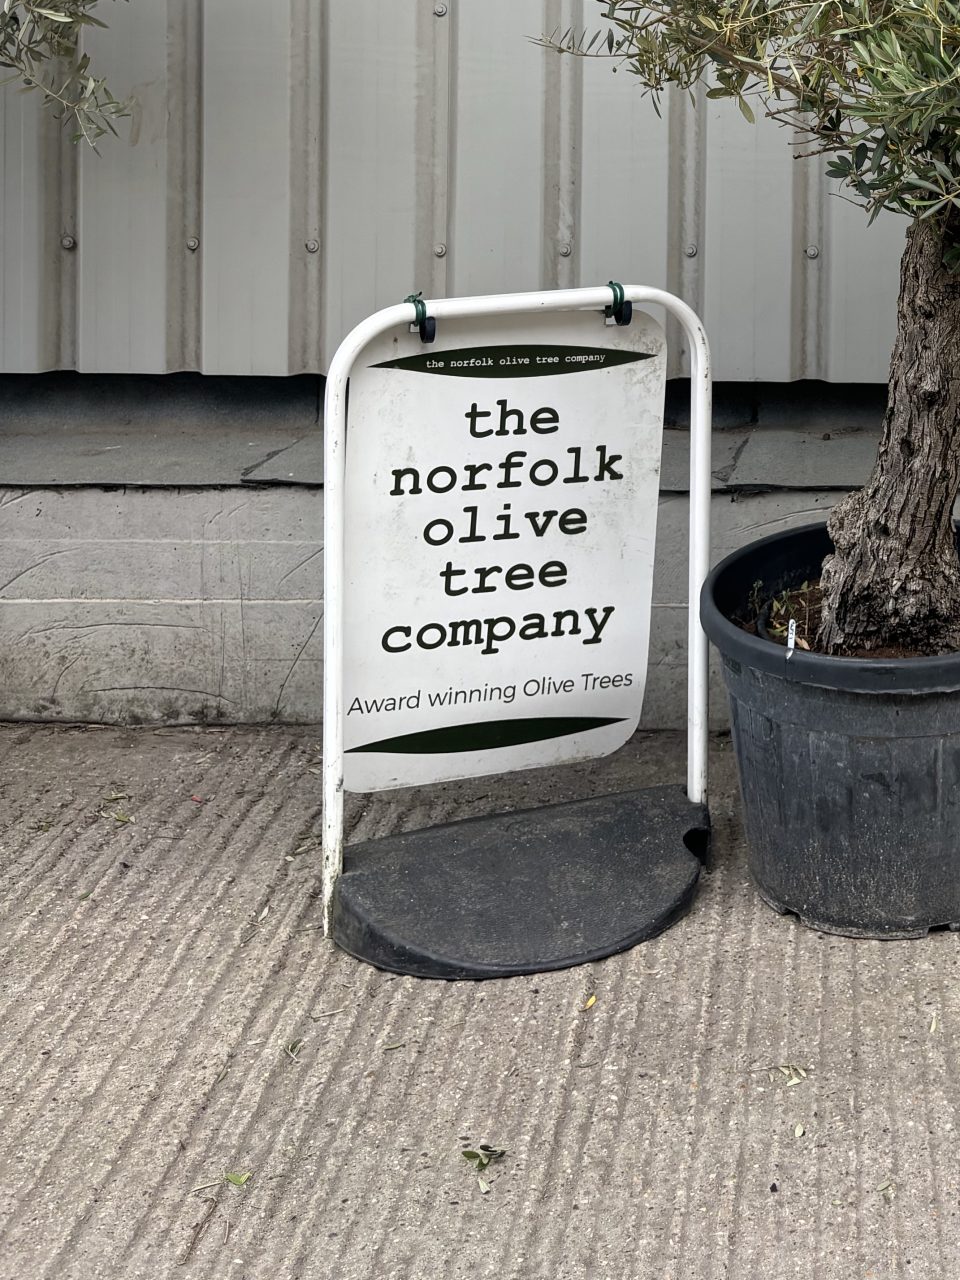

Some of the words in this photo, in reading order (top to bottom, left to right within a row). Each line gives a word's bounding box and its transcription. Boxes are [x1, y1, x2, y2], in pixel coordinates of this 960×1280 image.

[426, 359, 445, 369] the
[450, 357, 494, 368] norfolk
[499, 356, 530, 366] olive
[535, 355, 560, 364] tree
[564, 353, 606, 365] company
[464, 399, 560, 439] the
[389, 444, 624, 496] norfolk
[423, 502, 588, 547] olive
[439, 559, 568, 597] tree
[381, 605, 616, 655] company
[346, 690, 421, 716] Award
[427, 684, 517, 708] winning
[523, 676, 575, 697] Olive
[581, 671, 633, 692] Trees
